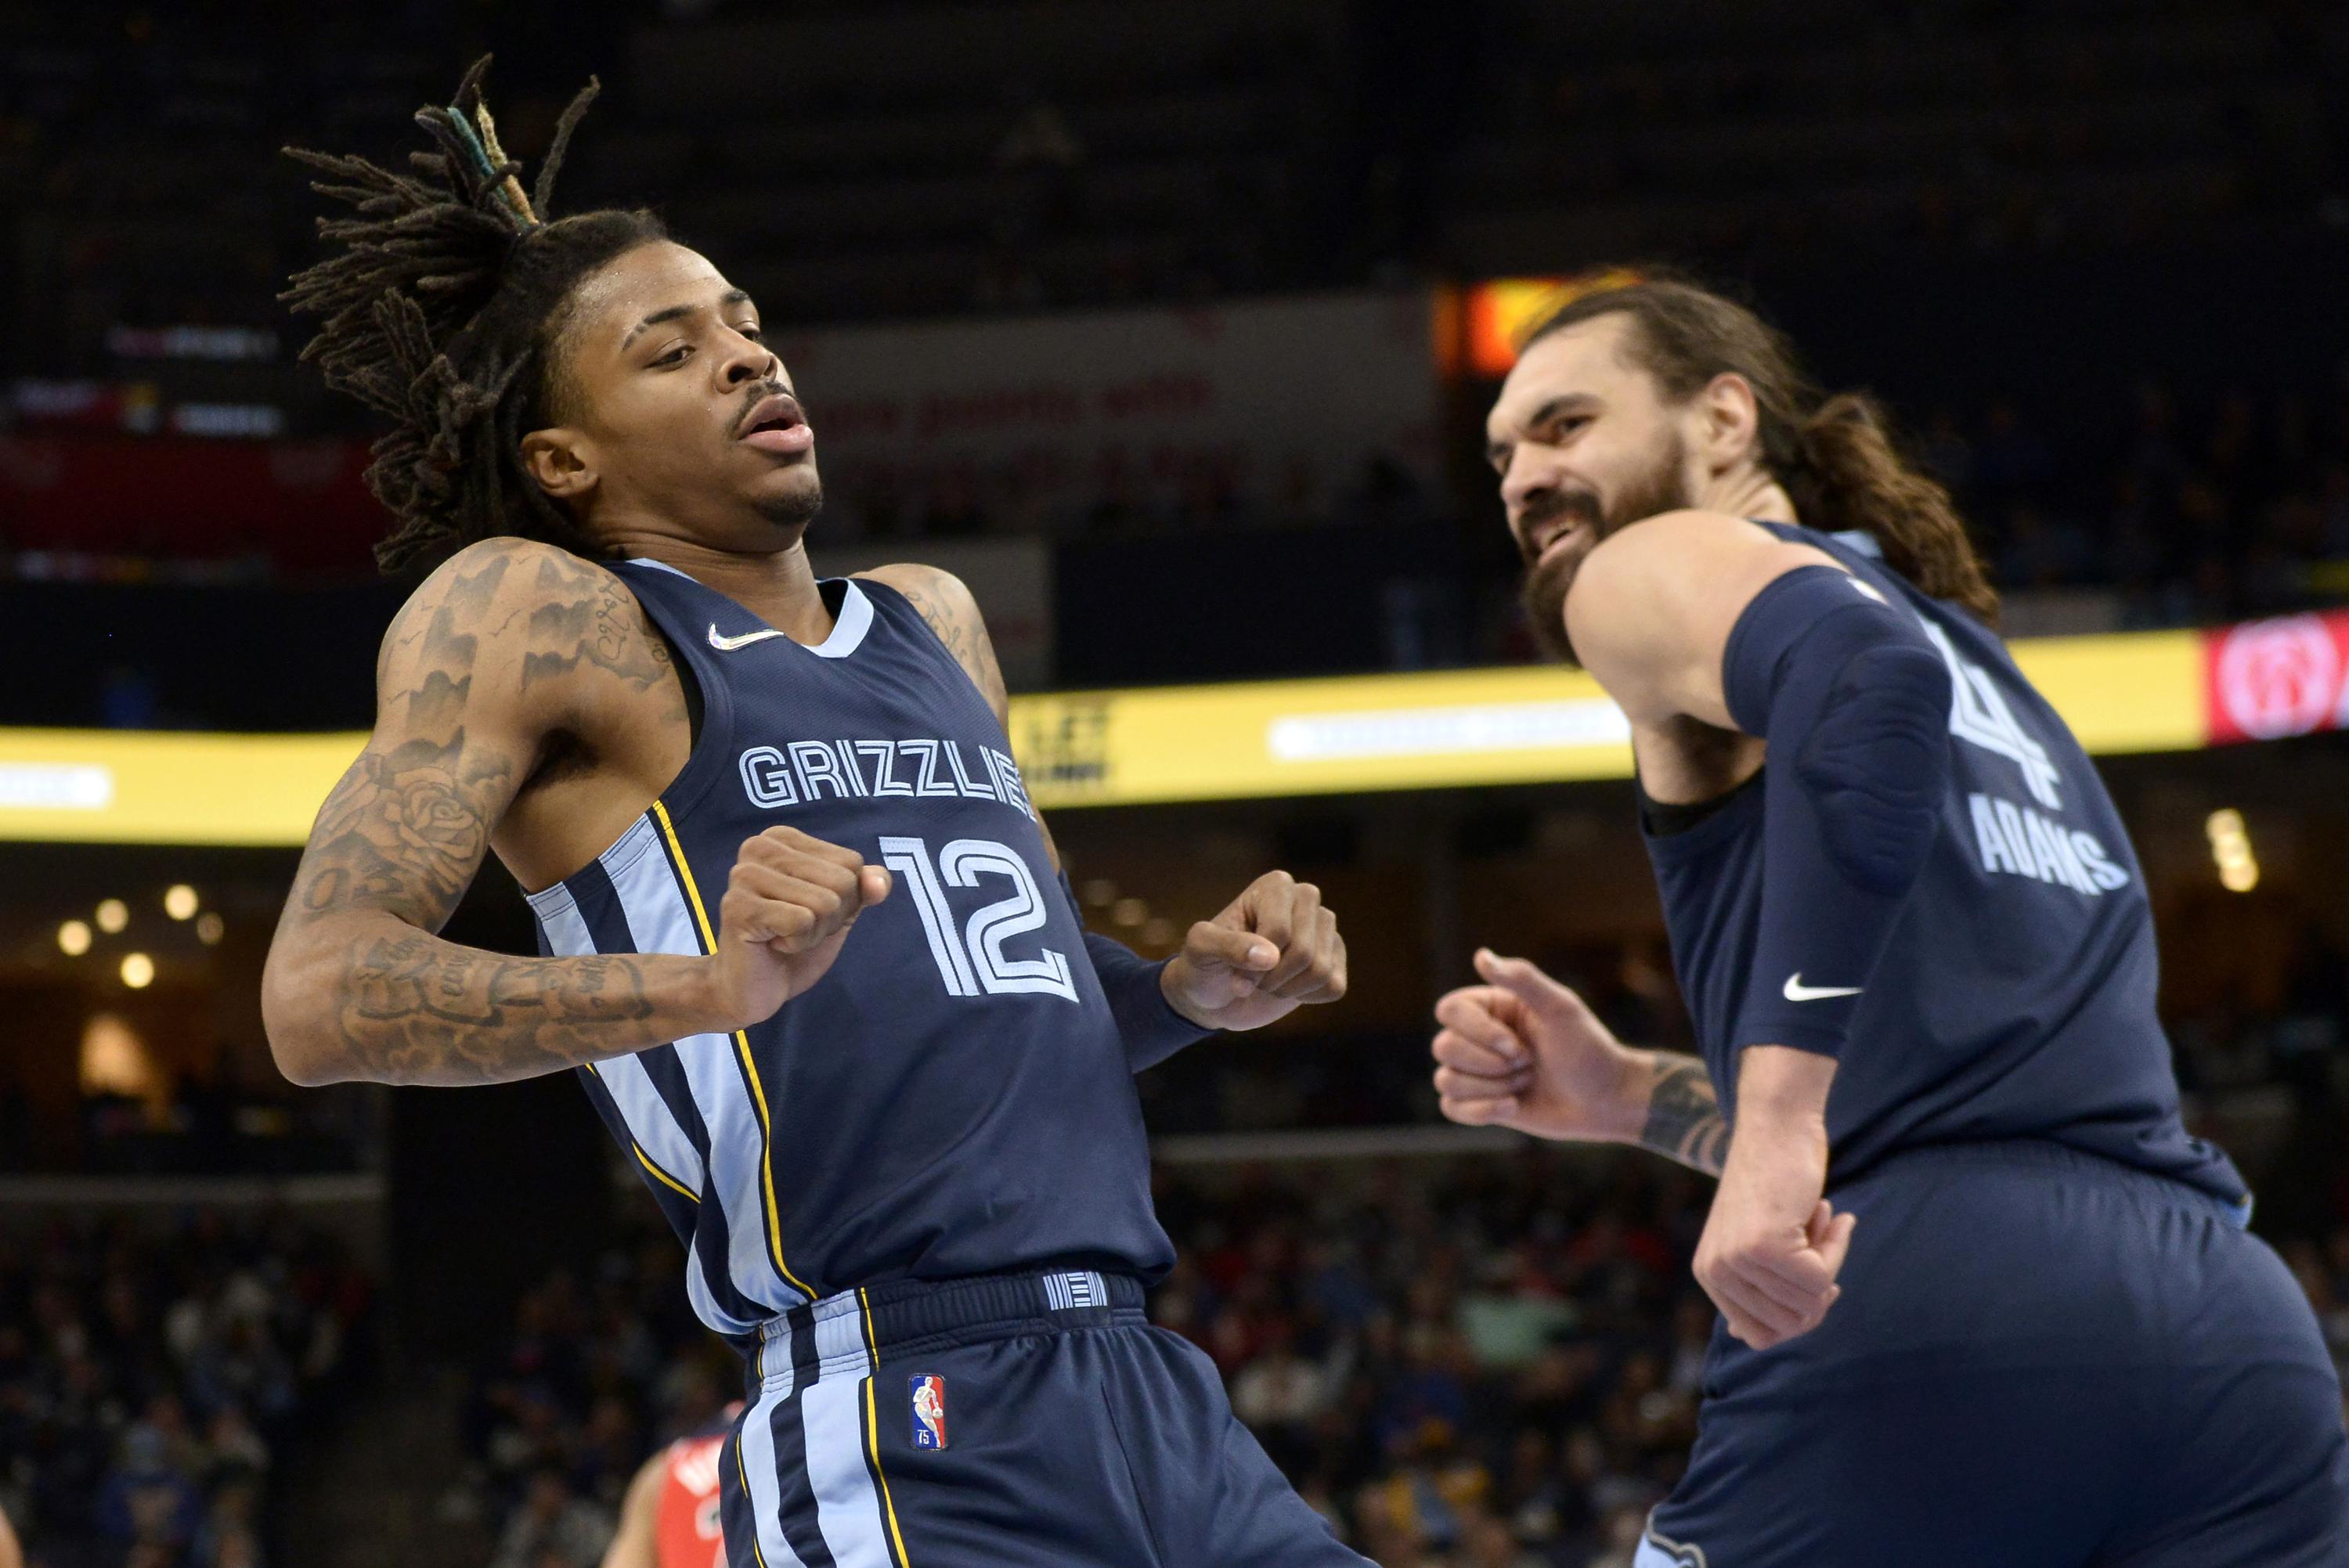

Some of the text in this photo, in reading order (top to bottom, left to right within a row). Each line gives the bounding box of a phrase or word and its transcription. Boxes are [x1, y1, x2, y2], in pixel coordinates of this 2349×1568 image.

[1920, 617, 2062, 810] 4
[739, 740, 1037, 823] GRIZZLIE
[1969, 793, 2130, 896] ADAMS
[879, 836, 1080, 1003] 12
[918, 1429, 929, 1444] 75
